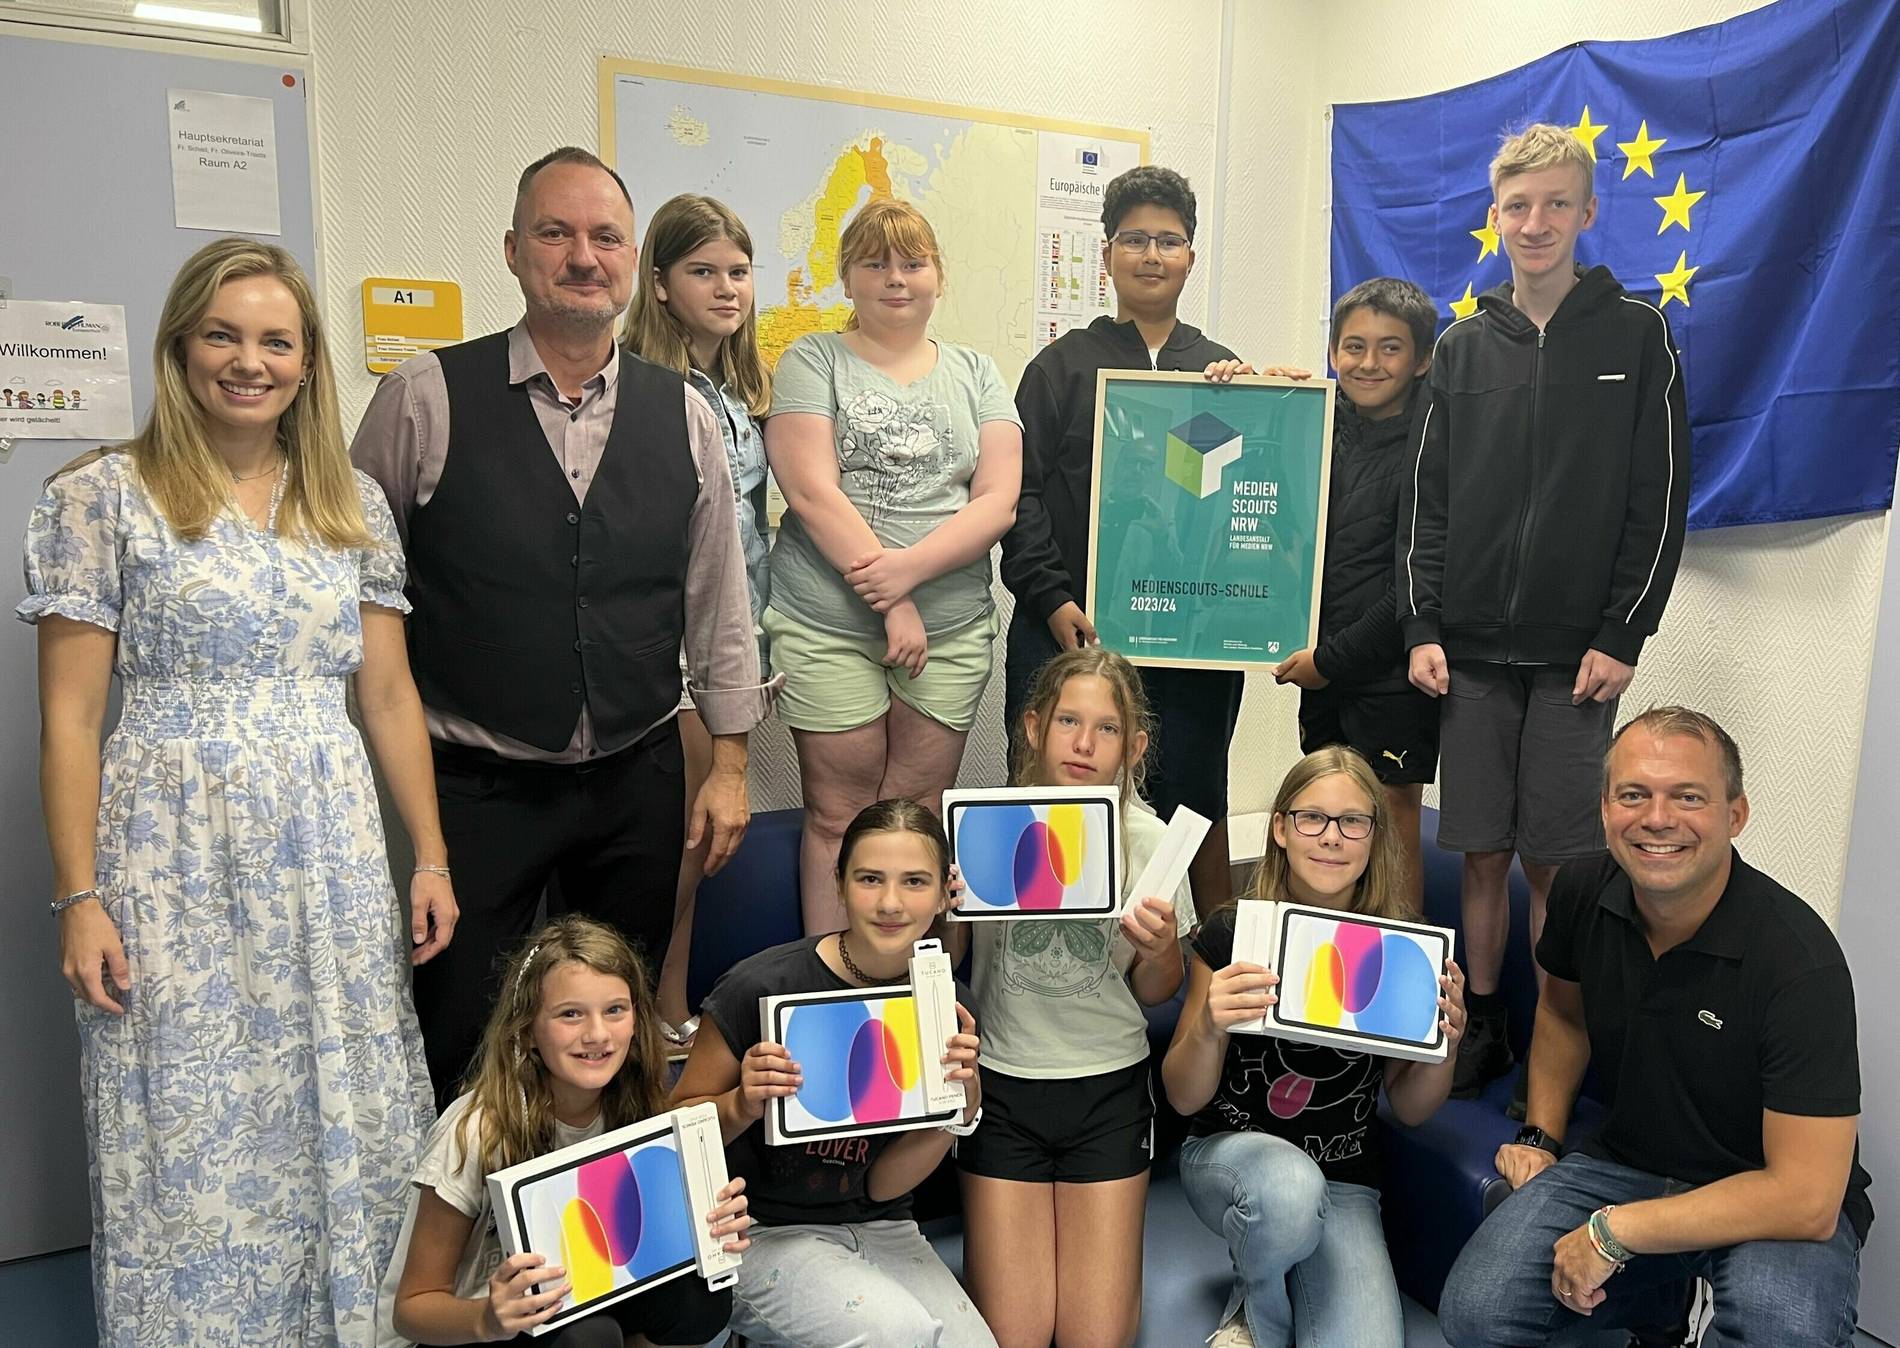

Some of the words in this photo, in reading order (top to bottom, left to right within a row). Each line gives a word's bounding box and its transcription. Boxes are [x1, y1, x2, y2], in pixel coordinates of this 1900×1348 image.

[178, 130, 264, 147] Hauptsekretariat
[199, 157, 230, 168] Raum
[234, 160, 247, 170] A2
[1050, 177, 1100, 196] Europäische
[394, 290, 413, 304] A1
[0, 343, 107, 360] Willkommen!
[1233, 480, 1278, 497] MEDIEN
[1232, 499, 1277, 514] SCOUTS
[1231, 517, 1258, 532] NRW
[1229, 535, 1271, 543] LANDESANSTALT
[1131, 579, 1269, 599] MEDIENSCOUTS-SCHULE
[1130, 596, 1177, 612] 2023/24
[805, 1138, 869, 1164] LOVER
